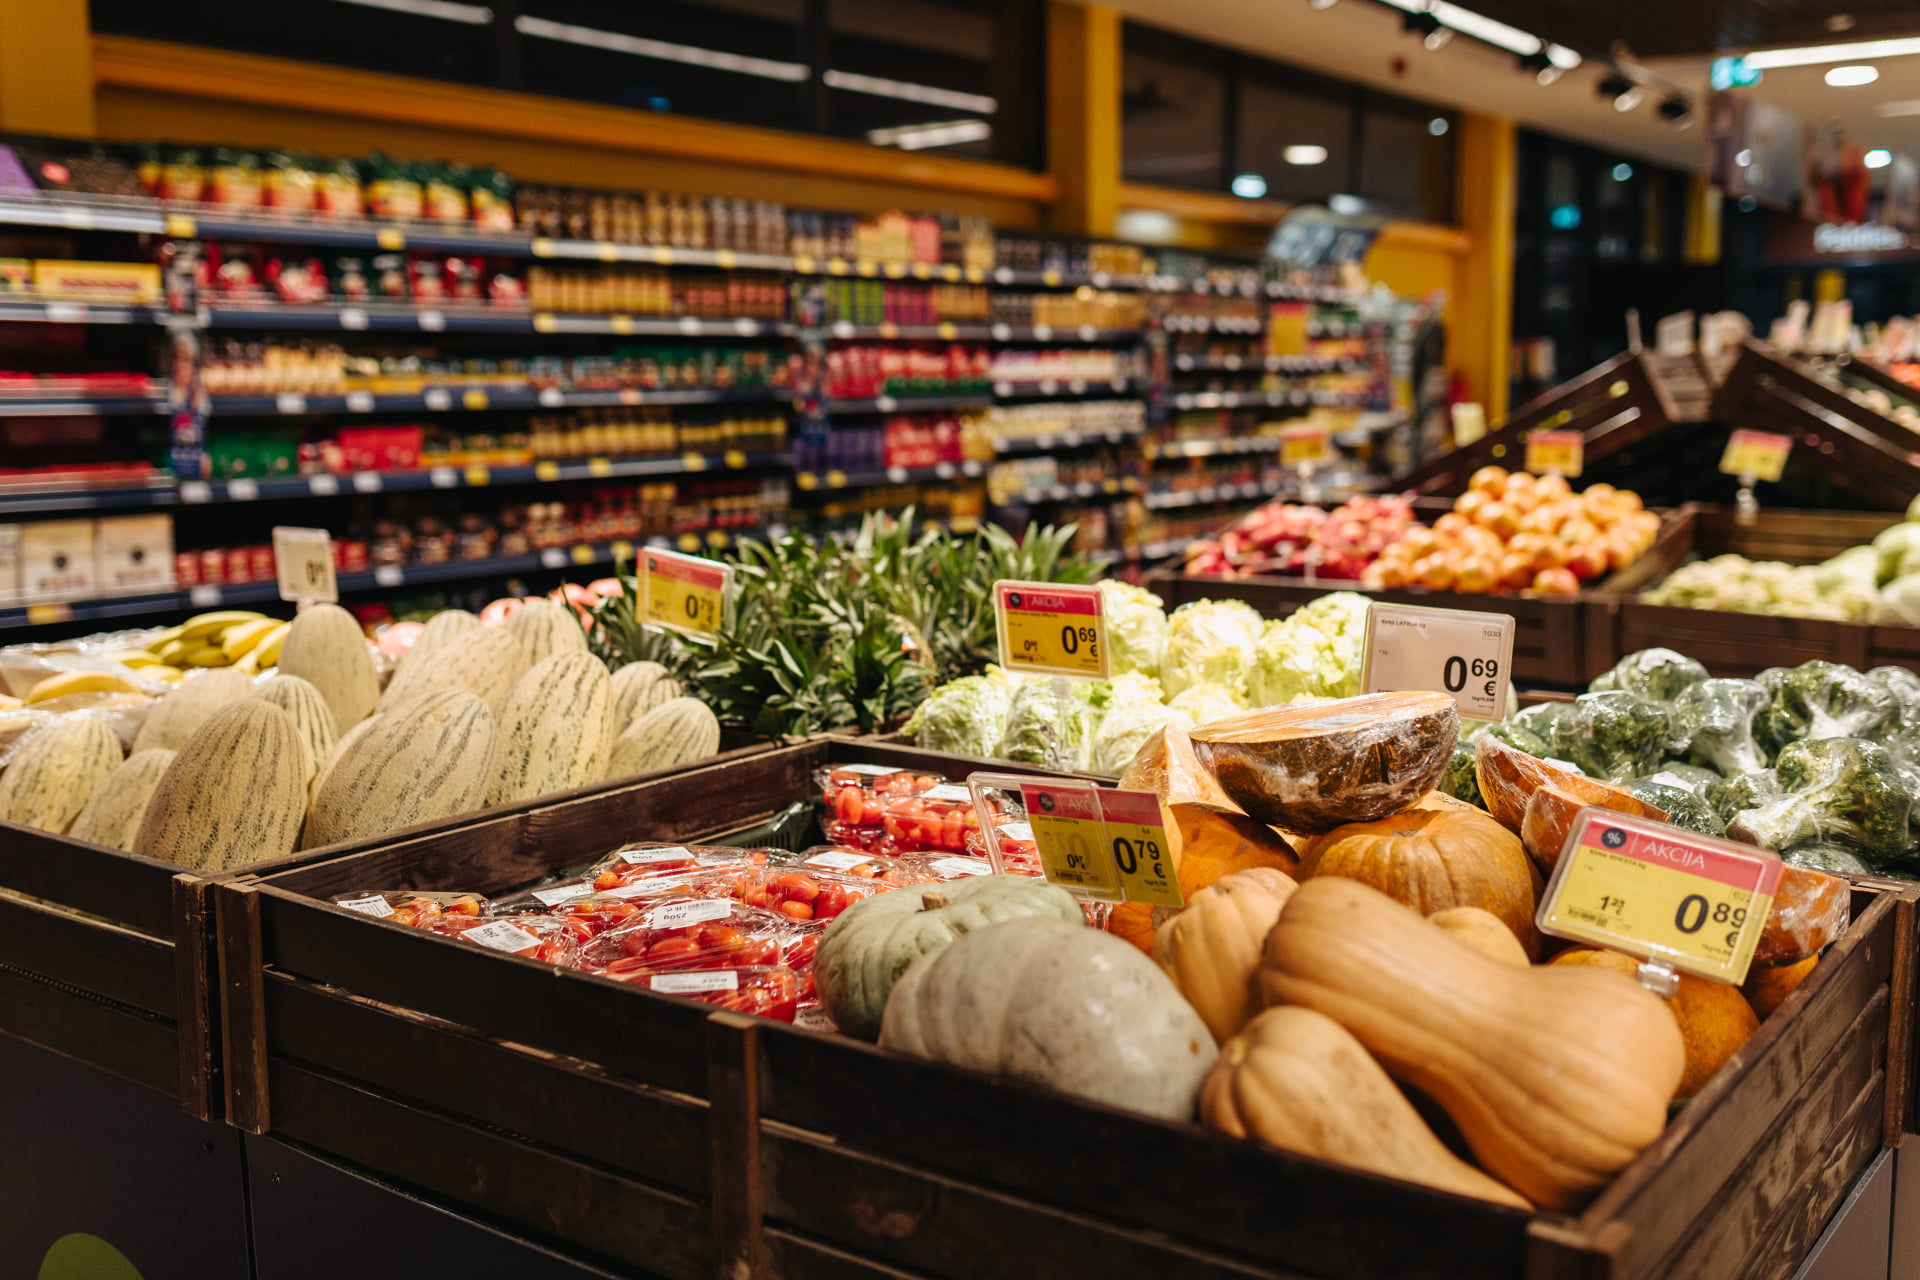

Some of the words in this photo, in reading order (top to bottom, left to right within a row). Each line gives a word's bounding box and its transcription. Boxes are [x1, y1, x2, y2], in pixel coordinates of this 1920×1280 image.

[686, 595, 698, 618] 0
[1062, 625, 1078, 655] 0
[1079, 627, 1096, 642] 69
[1483, 630, 1501, 638] 1030
[1443, 656, 1468, 692] 0
[1471, 658, 1498, 678] 69
[1484, 680, 1496, 696] €
[1141, 827, 1151, 835] 44
[1112, 837, 1138, 874] 0
[1134, 840, 1160, 860] 79
[1642, 841, 1705, 869] AKCIJA
[1154, 863, 1166, 879] €
[1600, 896, 1610, 910] 1
[1674, 894, 1710, 934] 0
[1712, 902, 1748, 929] 89
[1726, 931, 1738, 948] €
